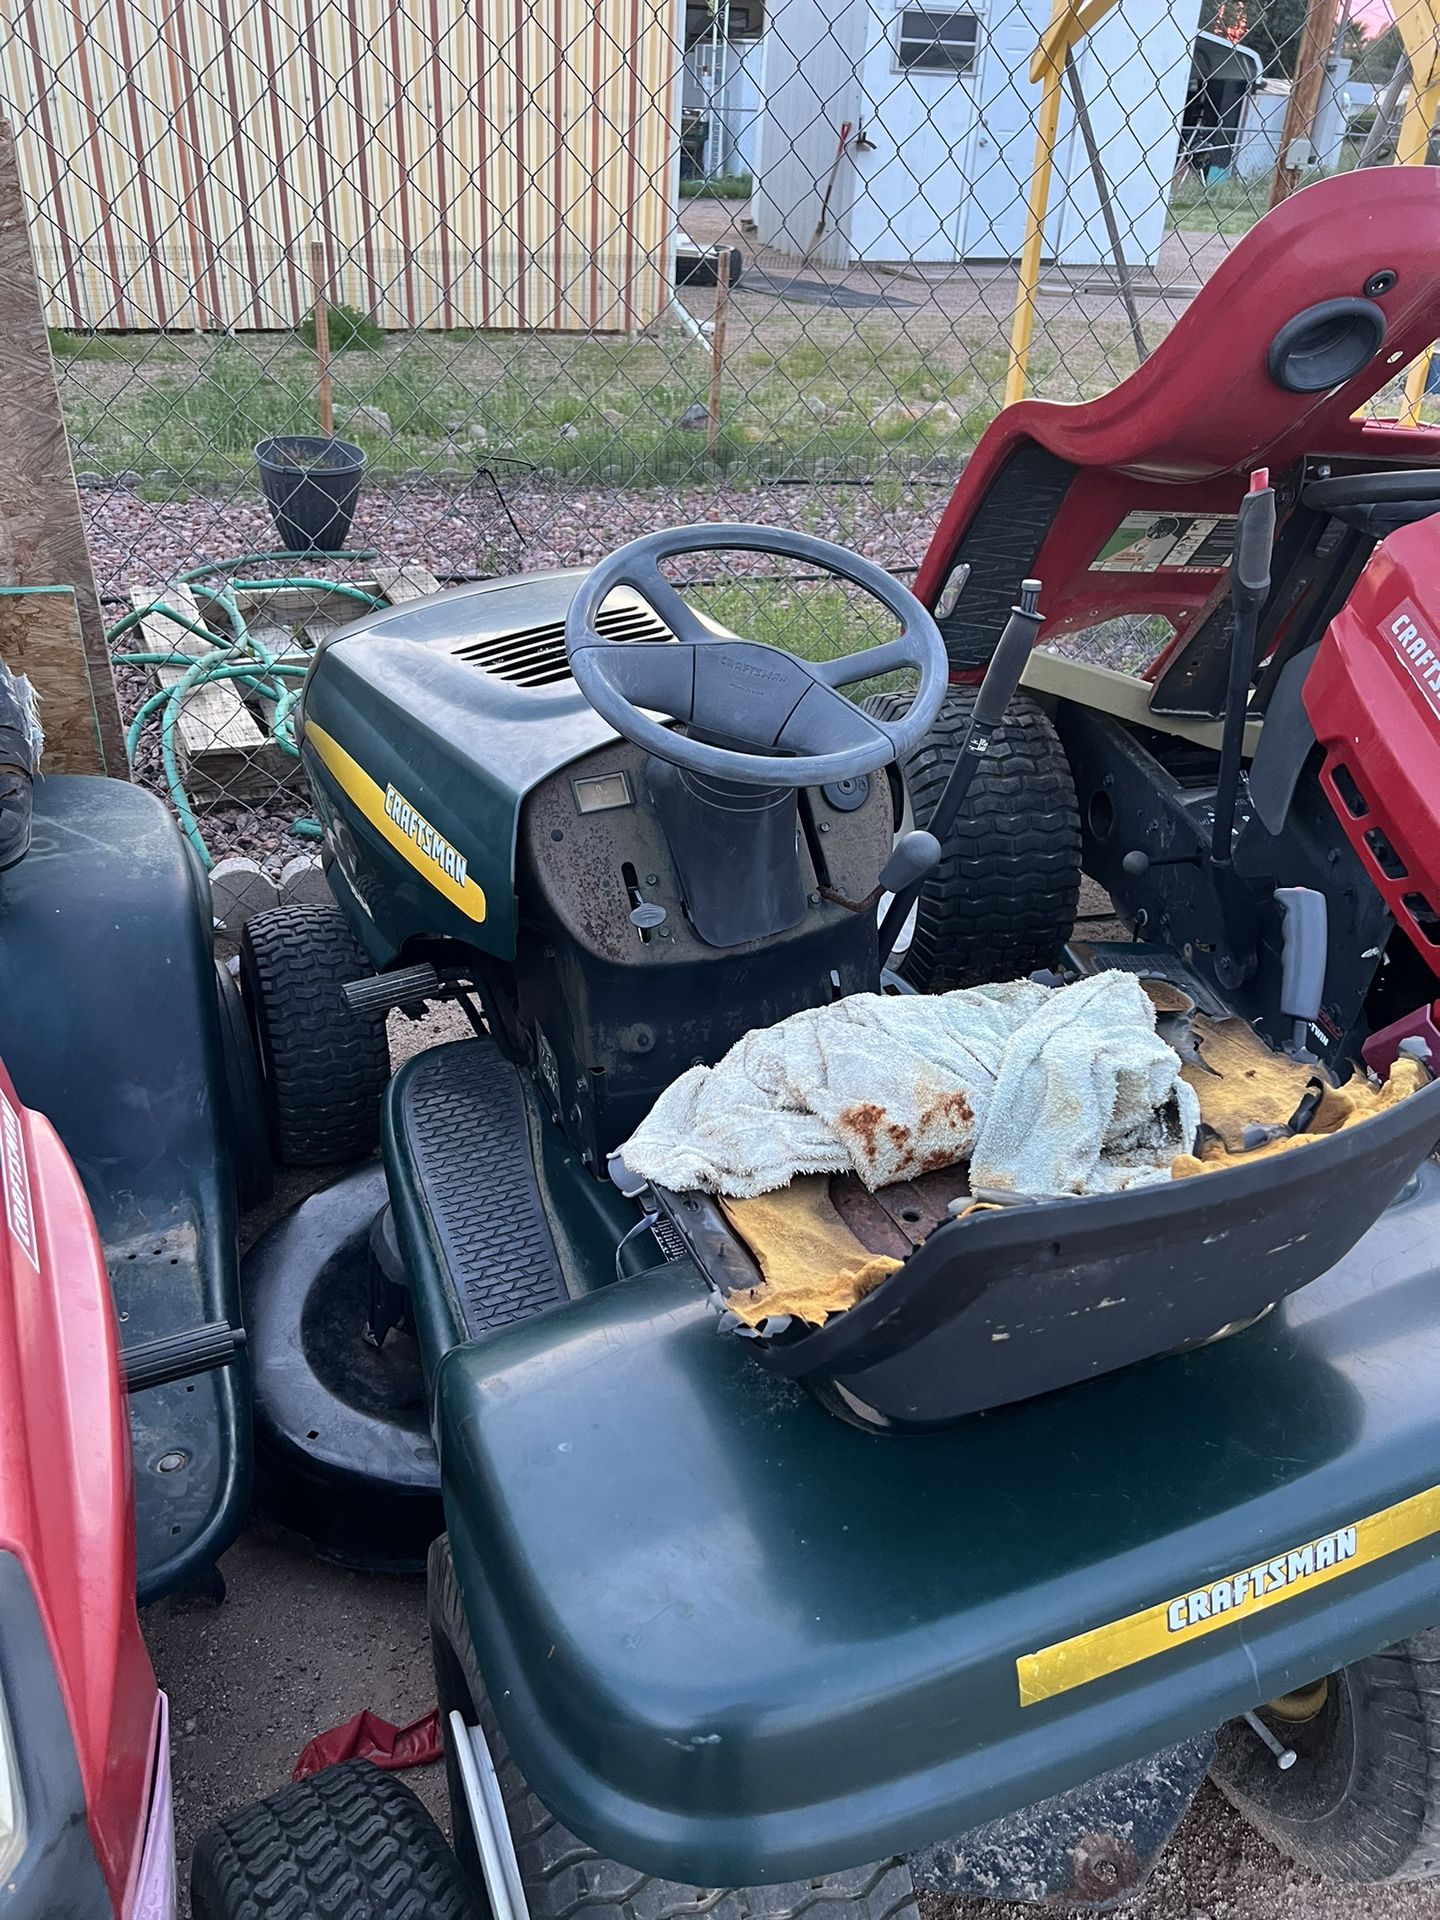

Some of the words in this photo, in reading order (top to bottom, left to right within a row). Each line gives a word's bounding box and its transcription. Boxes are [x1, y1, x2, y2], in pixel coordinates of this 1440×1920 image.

[720, 655, 789, 682] CRAFTSMAN
[384, 786, 467, 888] CRAFTSMAN
[1, 1102, 31, 1247] CRAFTSMAN
[1167, 1526, 1357, 1633] CRAFTSMAN
